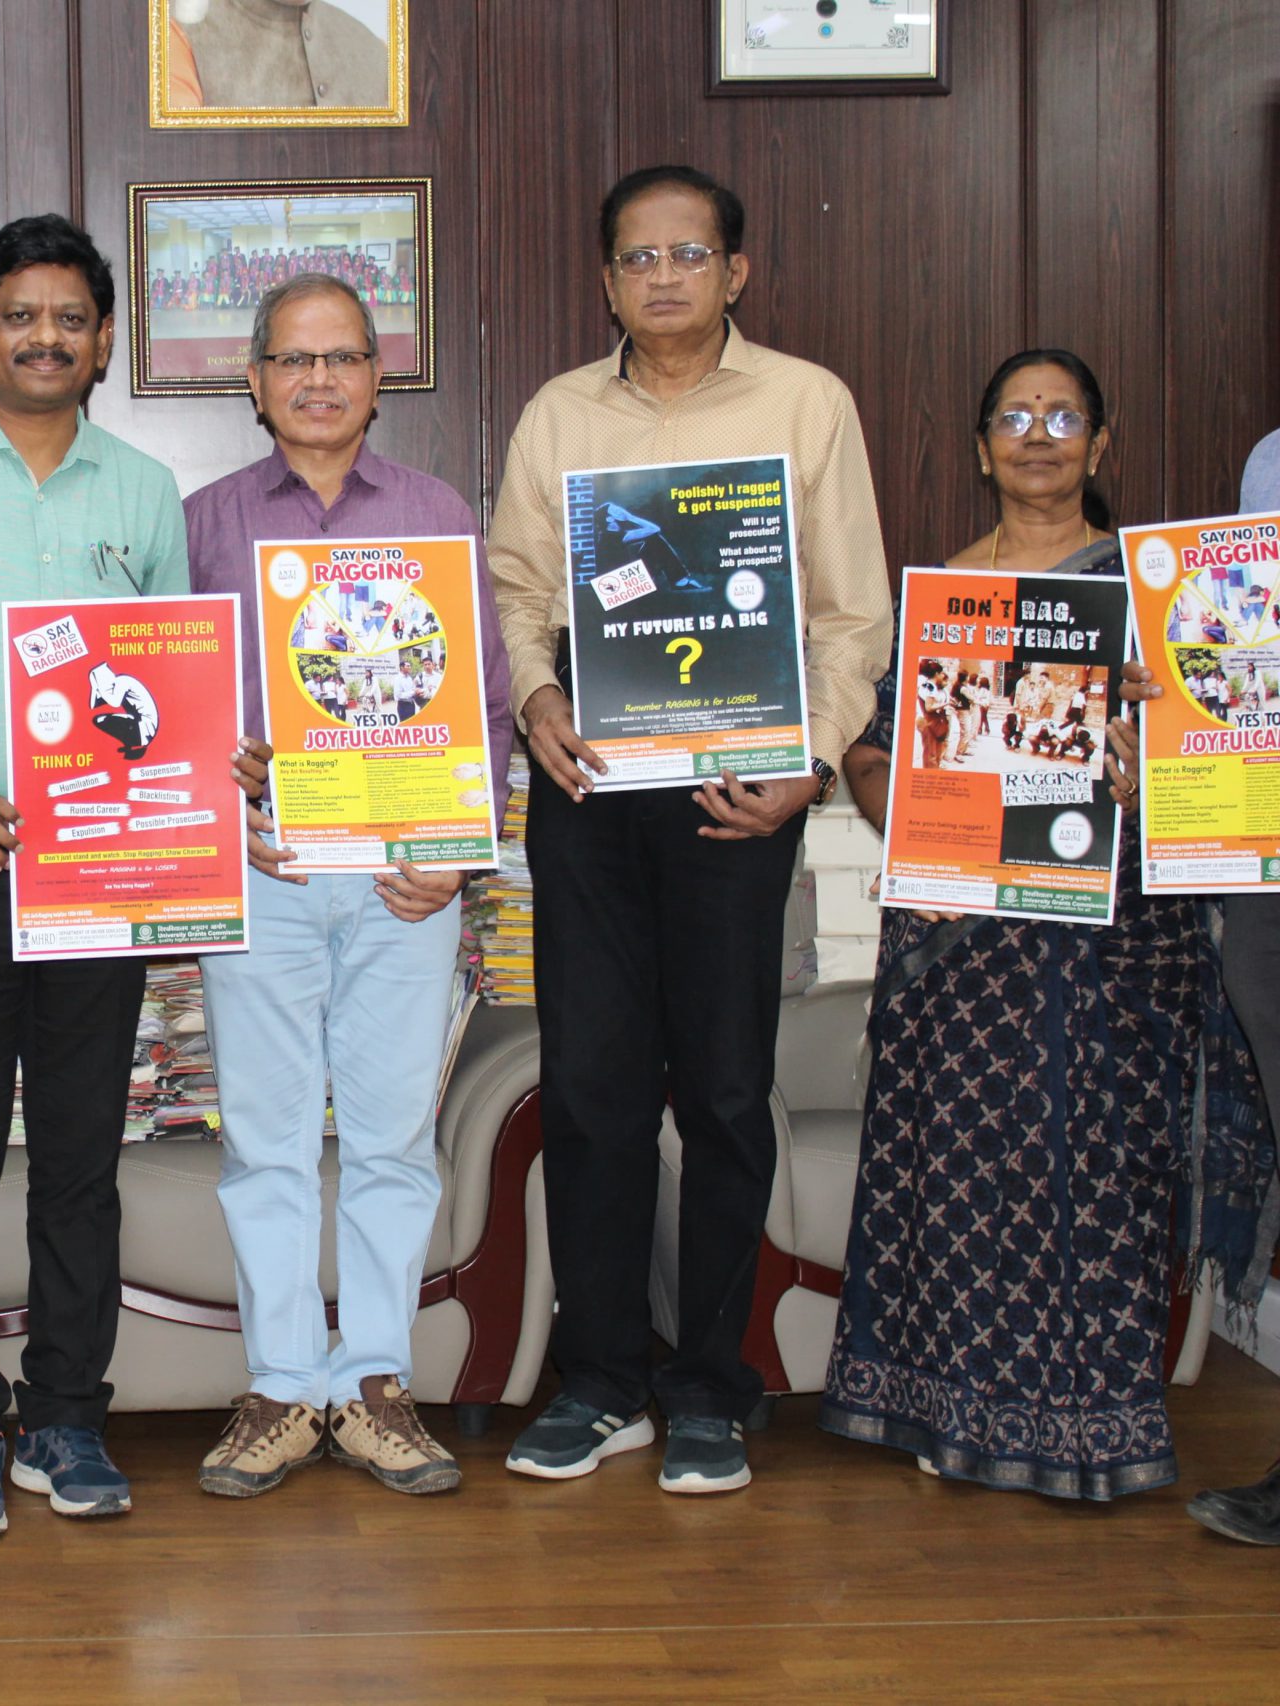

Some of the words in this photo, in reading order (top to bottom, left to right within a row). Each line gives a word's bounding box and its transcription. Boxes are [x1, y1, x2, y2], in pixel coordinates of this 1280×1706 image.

[671, 485, 725, 500] Foolishly
[729, 483, 733, 495] I
[737, 480, 780, 496] ragged
[678, 504, 688, 514] &
[691, 501, 712, 515] got
[715, 495, 781, 512] suspended
[743, 517, 759, 526] Will
[762, 517, 764, 525] I
[767, 516, 780, 527] get
[729, 527, 780, 540] prosecuted?
[1200, 531, 1228, 544] SAY
[1232, 529, 1252, 540] NO
[1258, 526, 1276, 538] TO
[332, 551, 356, 561] SAY
[362, 550, 381, 560] NO
[385, 549, 402, 559] TO
[720, 547, 742, 557] What
[744, 546, 767, 555] about
[769, 544, 782, 554] my
[1184, 541, 1279, 569] RAGGIN
[720, 558, 735, 568] Job
[737, 555, 783, 567] prospects?
[315, 562, 420, 582] RAGGING
[619, 564, 641, 581] SAY
[624, 577, 639, 587] NO
[607, 581, 652, 606] RAGGING
[947, 592, 1013, 618] DON'T
[1022, 601, 1075, 624] RAG,
[46, 621, 71, 641] SAY
[110, 624, 154, 638] BEFORE
[157, 623, 181, 636] YOU
[185, 621, 214, 635] EVEN
[604, 623, 628, 638] MY
[633, 618, 694, 636] FUTURE
[699, 616, 716, 630] IS
[721, 614, 734, 628] A
[739, 611, 768, 627] BIG
[52, 635, 68, 649] NO
[920, 622, 977, 644] JUST
[985, 624, 1100, 650] INTERACT
[110, 643, 145, 656] THINK
[148, 642, 163, 655] OF
[167, 640, 219, 654] RAGGING
[32, 643, 83, 672] RAGGING
[665, 636, 703, 684] ?
[625, 704, 662, 713] Remember
[666, 699, 701, 709] RAGGING
[713, 698, 724, 706] for
[727, 694, 758, 705] LOSERS
[354, 715, 377, 727] YES
[381, 714, 398, 726] TO
[1235, 713, 1260, 727] YES
[1265, 712, 1280, 726] TO
[306, 726, 449, 749] JOYFULCAMPUS
[1183, 729, 1280, 753] JOYFULCA
[32, 755, 72, 769] THINK
[76, 754, 94, 767] OF
[307, 760, 338, 768] Ragging?
[140, 765, 181, 777] Suspension
[1006, 771, 1089, 787] RAGGING
[59, 777, 99, 792] Humiliation
[139, 791, 180, 801] Blacklisting
[1006, 793, 1090, 804] PUNISHABLE
[70, 806, 95, 814] Ruined
[96, 806, 120, 814] Career
[136, 817, 166, 829] Possible
[167, 813, 209, 825] Prosecution
[72, 826, 106, 837] Expulsion
[44, 854, 60, 862] Don't
[73, 852, 89, 860] stand
[123, 851, 136, 859] Stop
[183, 848, 211, 856] Character
